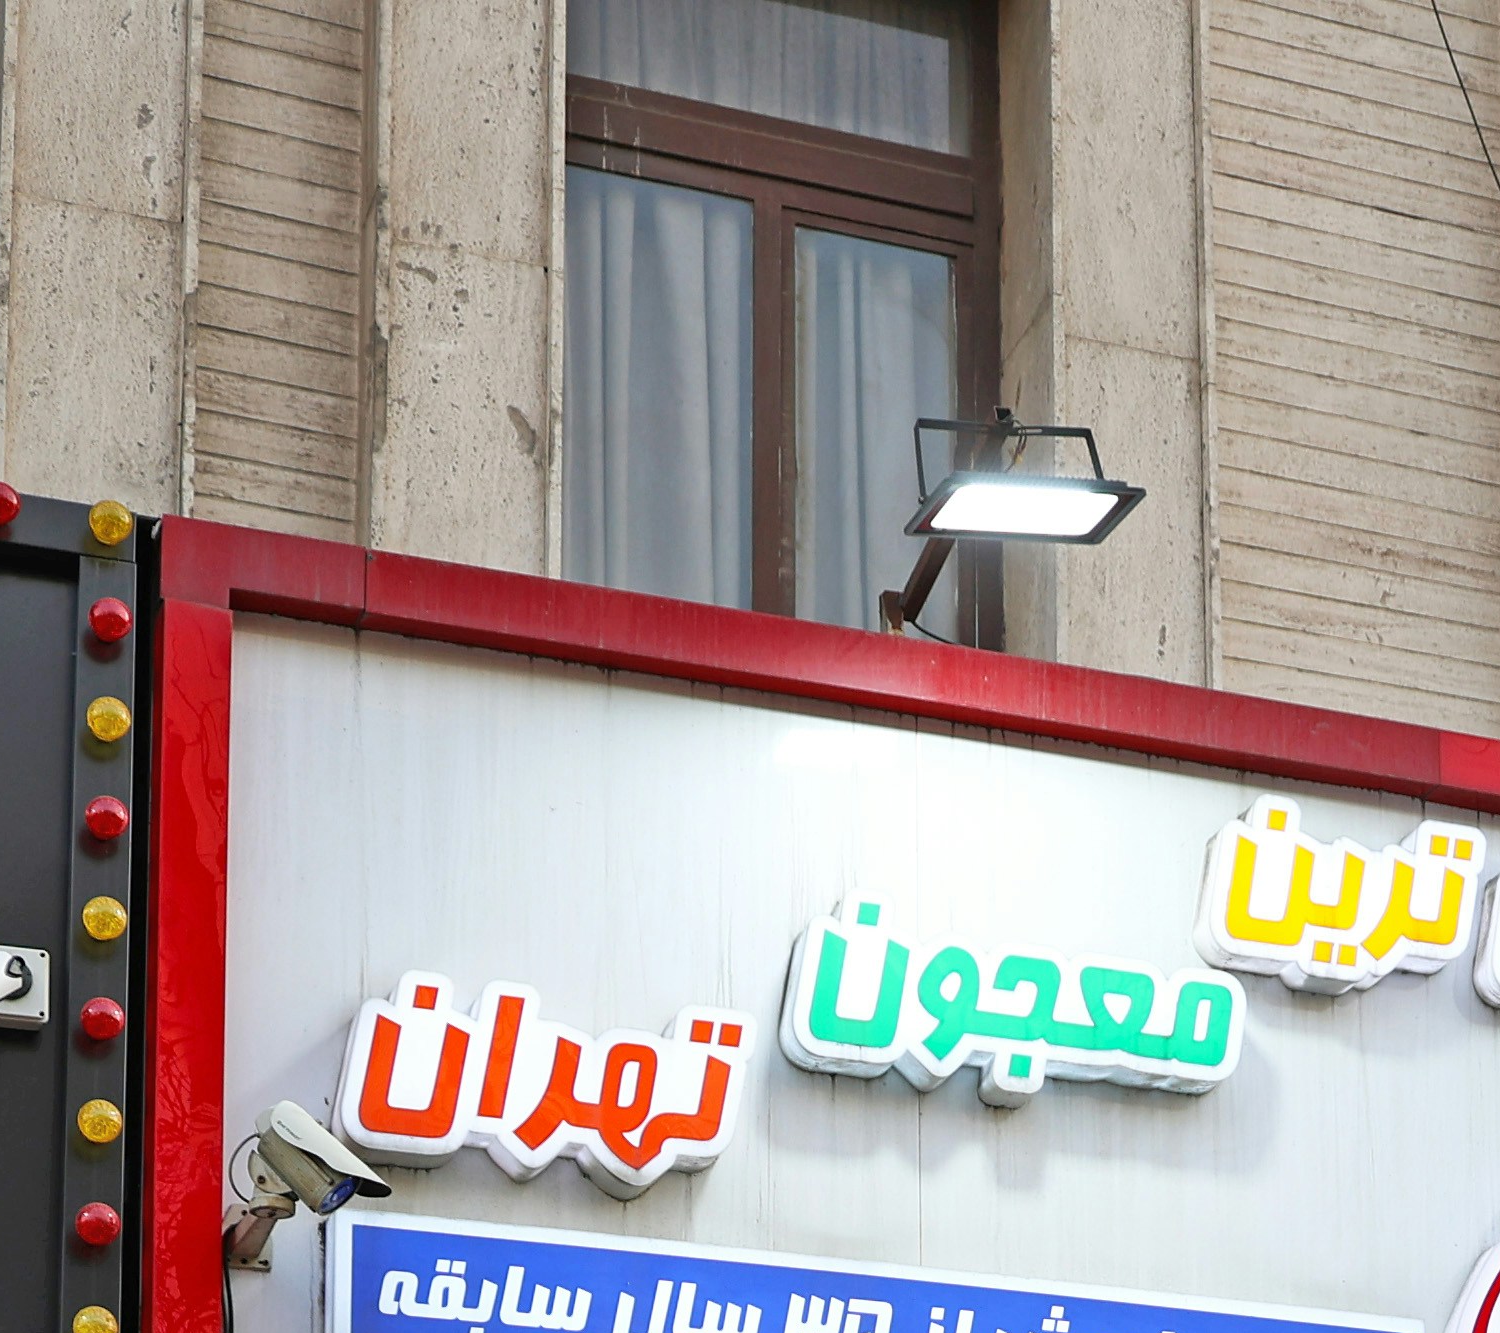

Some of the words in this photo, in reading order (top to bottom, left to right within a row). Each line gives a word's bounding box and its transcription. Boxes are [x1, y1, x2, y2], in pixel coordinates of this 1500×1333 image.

[1228, 811, 1471, 965] ترین
[361, 986, 741, 1167] تهران
[809, 903, 1233, 1078] معجون
